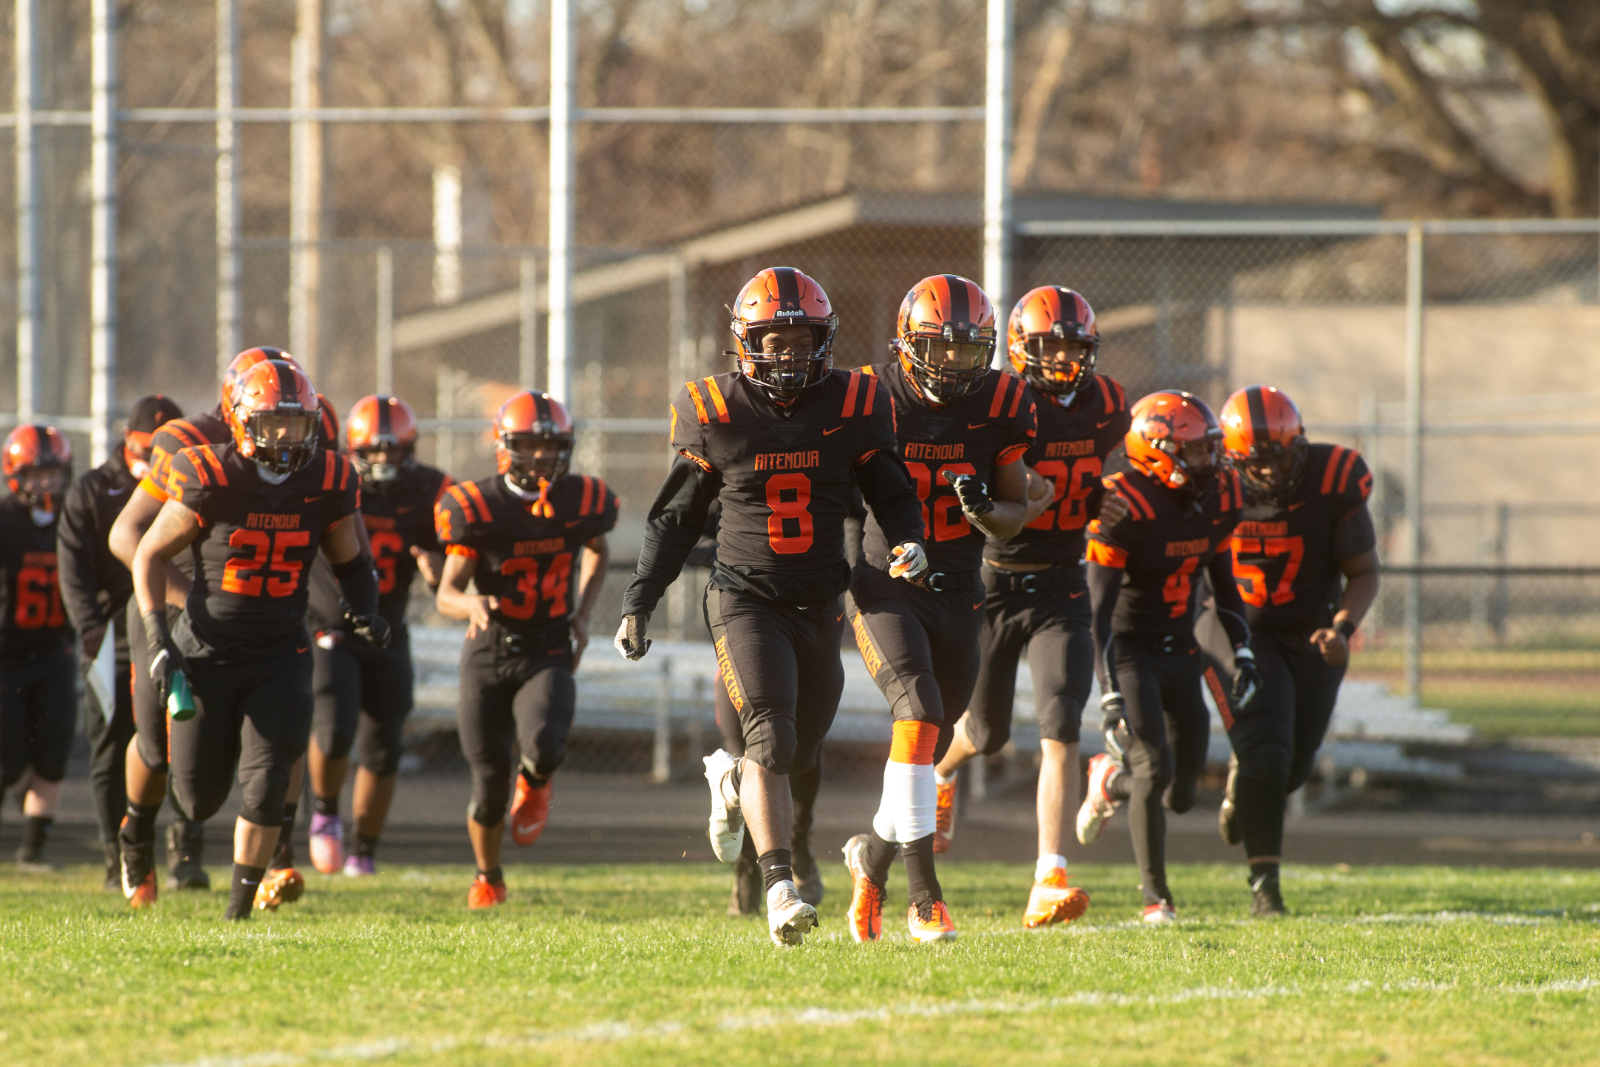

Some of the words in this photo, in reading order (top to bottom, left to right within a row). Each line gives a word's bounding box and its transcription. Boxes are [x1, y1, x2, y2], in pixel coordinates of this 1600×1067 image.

[754, 450, 820, 471] RITENOUR
[905, 442, 965, 460] RITENOUR
[1045, 439, 1095, 458] RITENOUR
[246, 512, 301, 530] RITENOUR
[765, 472, 814, 555] 8
[1025, 456, 1103, 531] 26
[221, 528, 311, 598] 25
[500, 552, 573, 620] 34
[1162, 556, 1200, 619] 4
[1229, 535, 1305, 608] 57
[715, 635, 744, 713] HUSKIES
